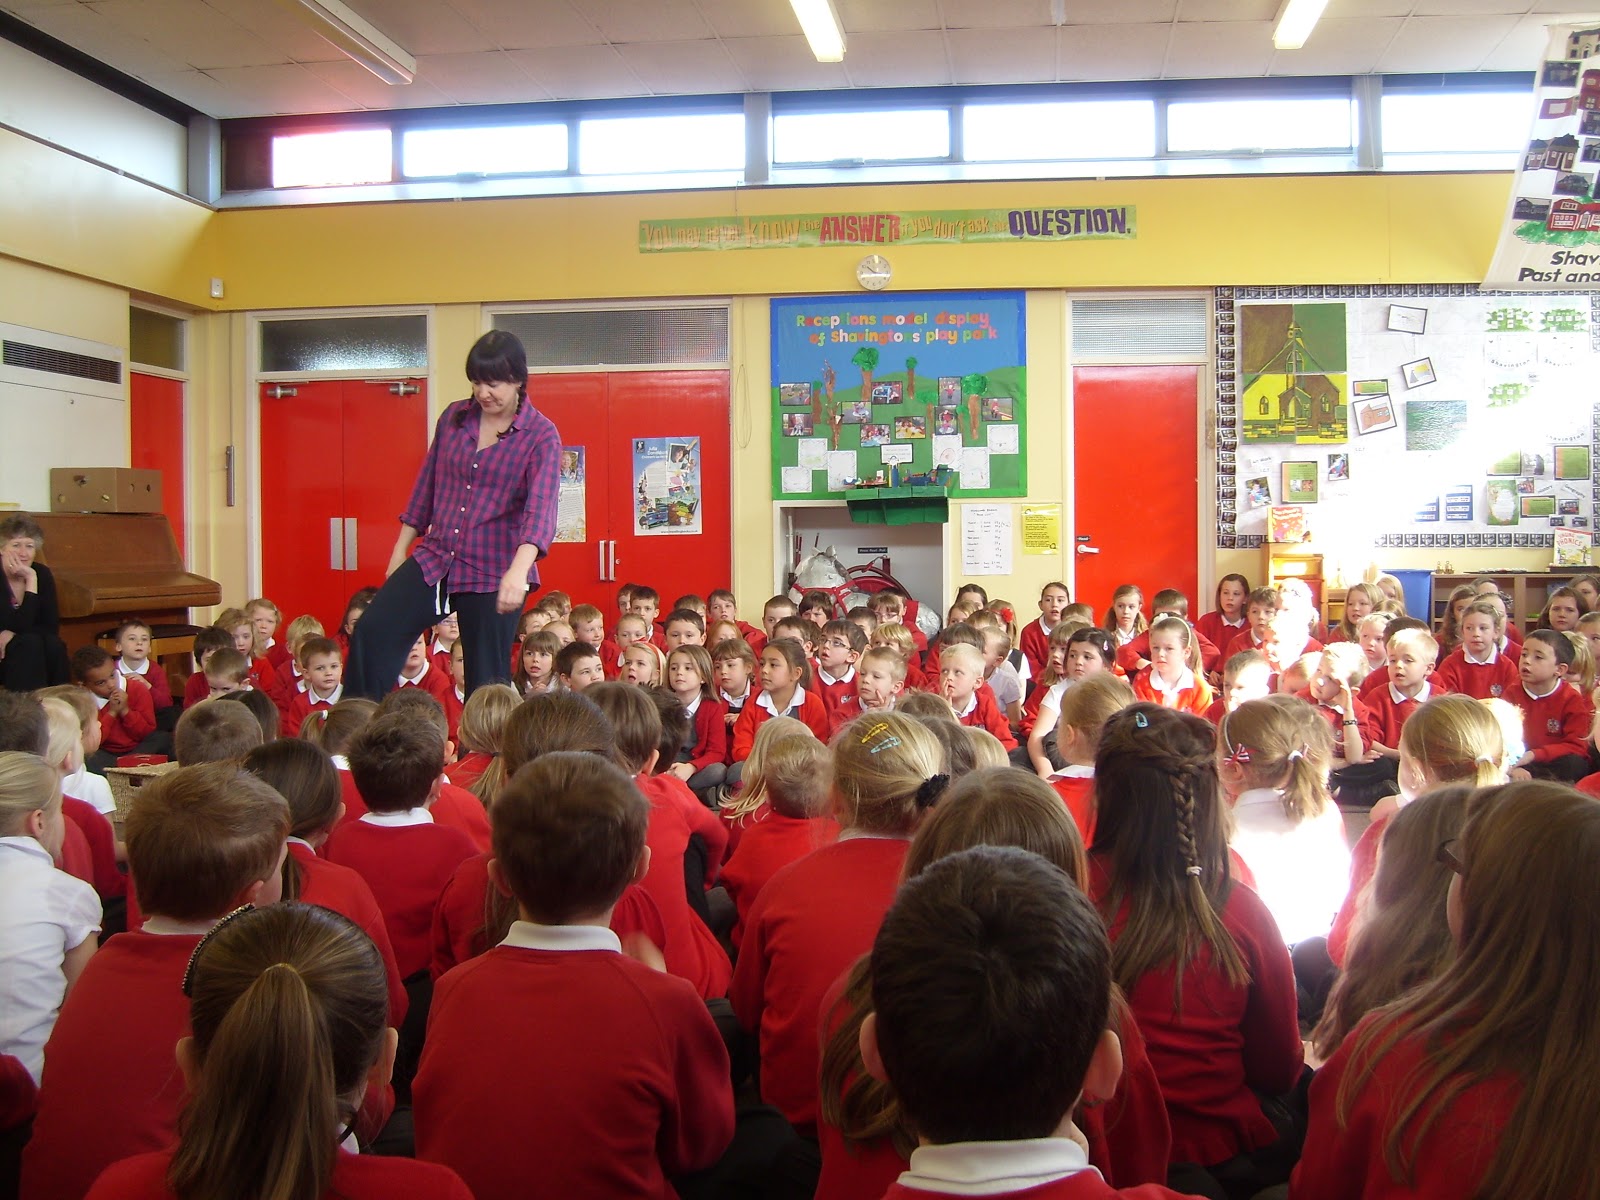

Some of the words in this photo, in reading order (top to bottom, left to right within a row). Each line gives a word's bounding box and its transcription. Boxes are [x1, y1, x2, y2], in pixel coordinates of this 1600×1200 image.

[676, 226, 701, 249] may
[744, 215, 800, 248] know
[804, 220, 820, 232] the
[819, 213, 901, 244] ANSWER
[911, 216, 933, 239] you
[934, 218, 967, 240] don't
[968, 217, 990, 234] ask
[1008, 207, 1131, 239] QUESTION.
[1550, 251, 1600, 266] Shav
[1518, 267, 1562, 282] Past
[796, 312, 877, 329] Receptions
[882, 312, 928, 326] model
[934, 311, 990, 329] display
[809, 332, 826, 347] of
[926, 328, 958, 346] play
[962, 326, 999, 343] park
